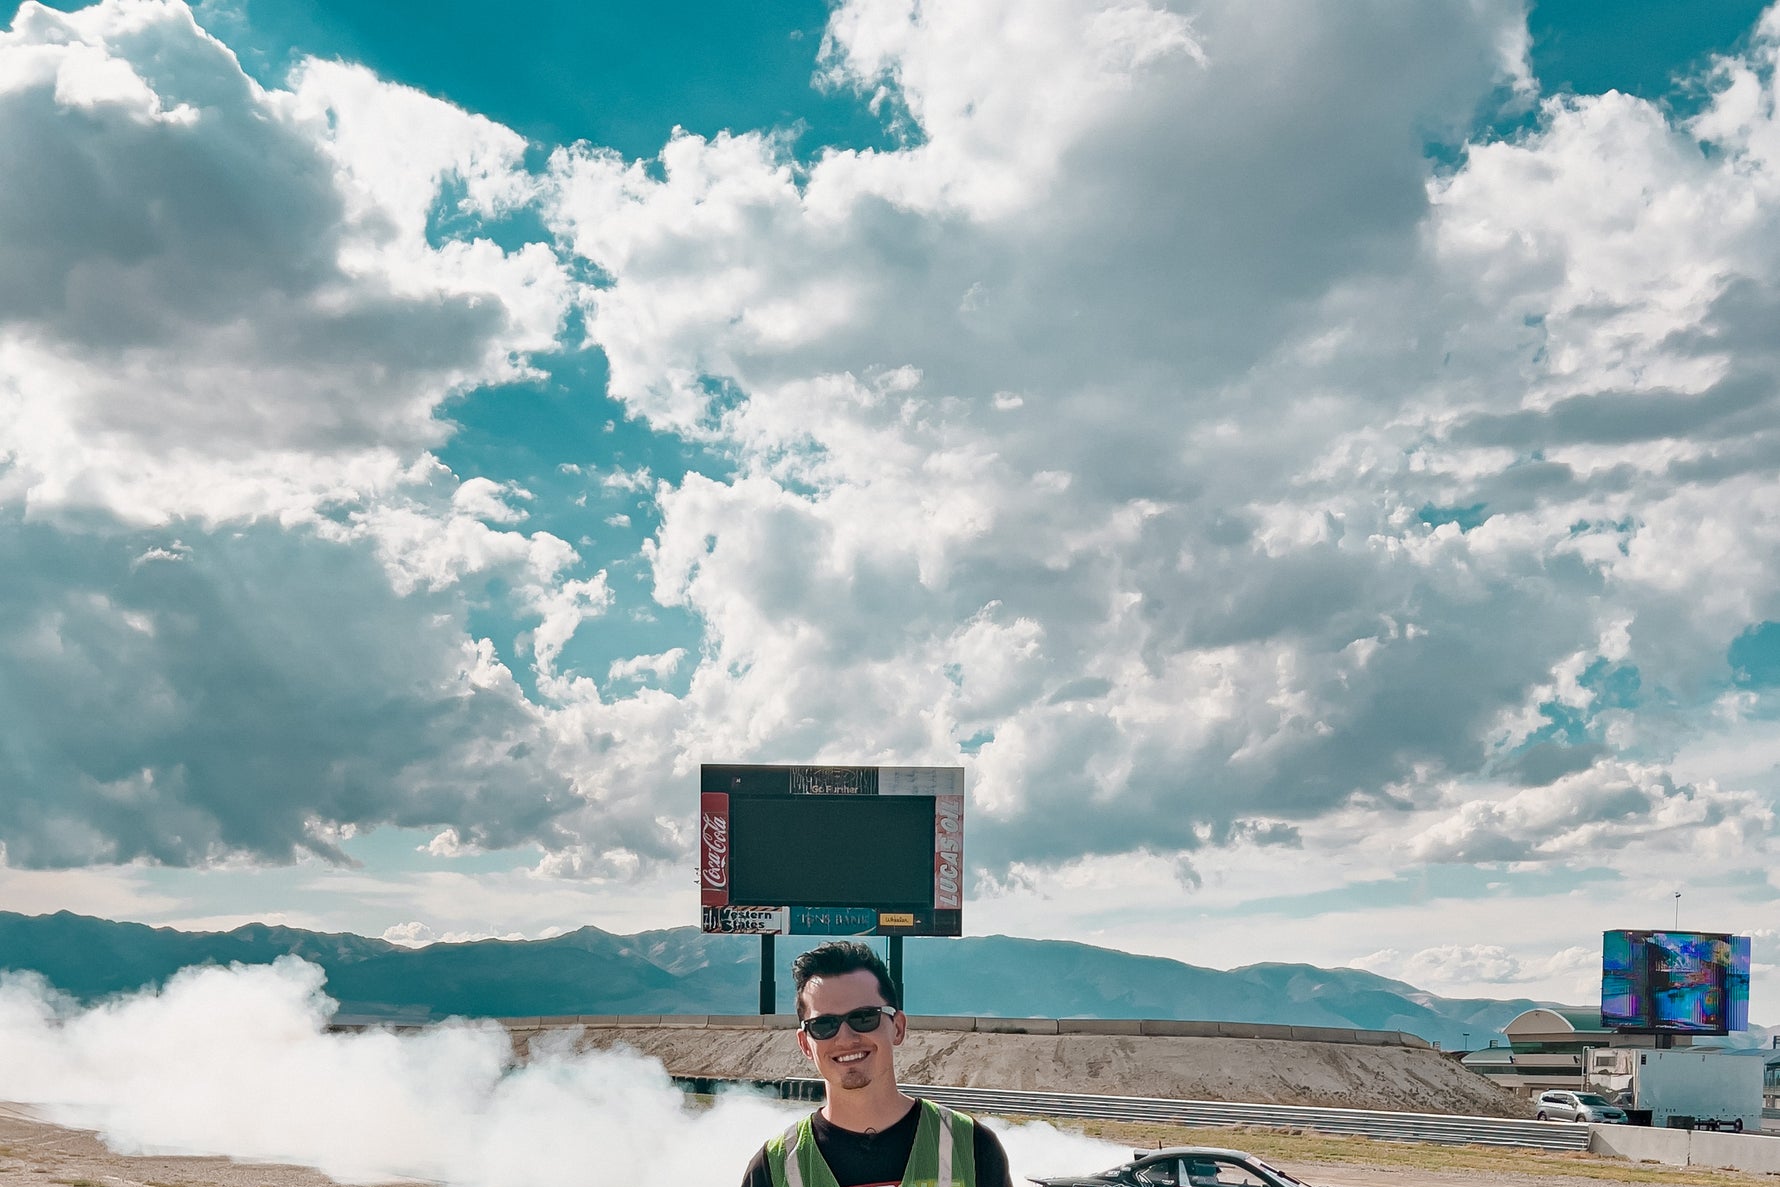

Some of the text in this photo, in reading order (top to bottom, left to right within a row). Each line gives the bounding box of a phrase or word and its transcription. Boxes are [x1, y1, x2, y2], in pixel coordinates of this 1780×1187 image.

[702, 812, 727, 888] Coca-Cola
[940, 799, 960, 908] LUCAS OIL
[720, 908, 772, 920] Western
[721, 919, 765, 931] States
